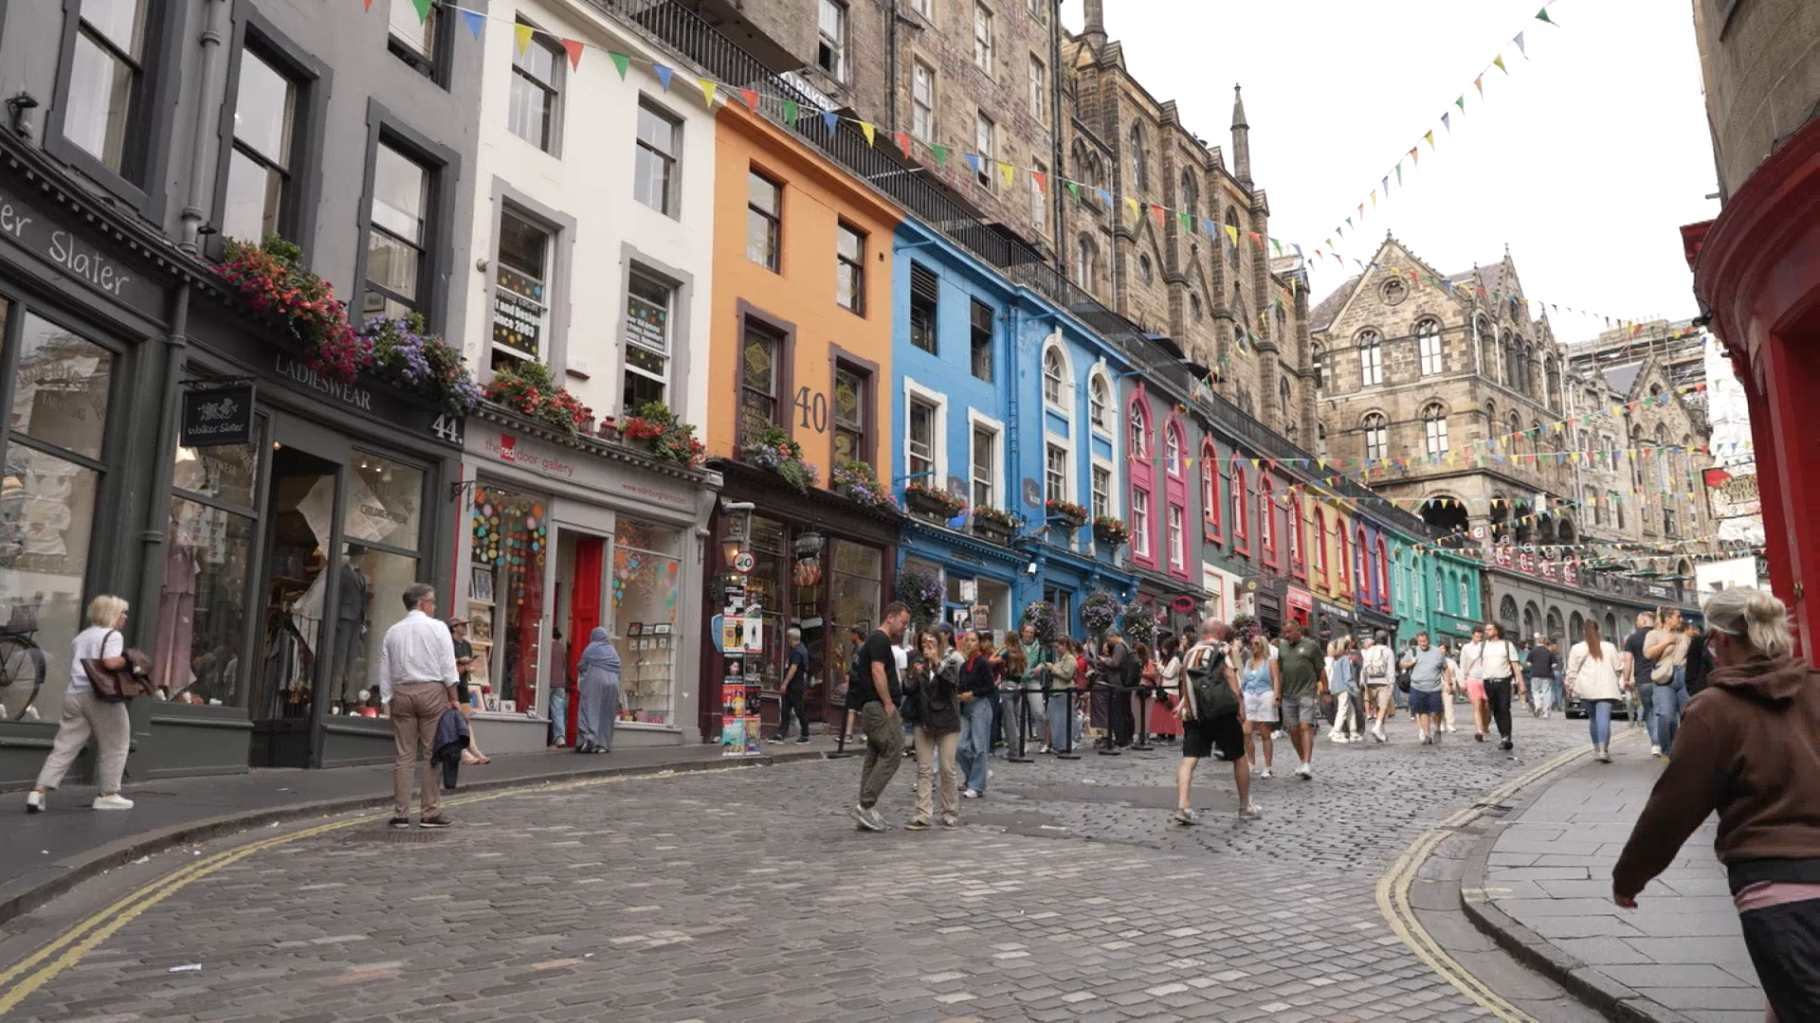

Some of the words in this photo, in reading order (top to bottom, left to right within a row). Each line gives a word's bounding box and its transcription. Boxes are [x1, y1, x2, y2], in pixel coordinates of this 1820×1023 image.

[0, 197, 32, 237] er
[48, 230, 130, 295] Slater
[275, 354, 371, 409] LADIESWEAR
[219, 422, 245, 433] Slater
[484, 438, 501, 455] the
[516, 448, 539, 464] door
[541, 458, 575, 478] gallery
[736, 556, 752, 568] 20
